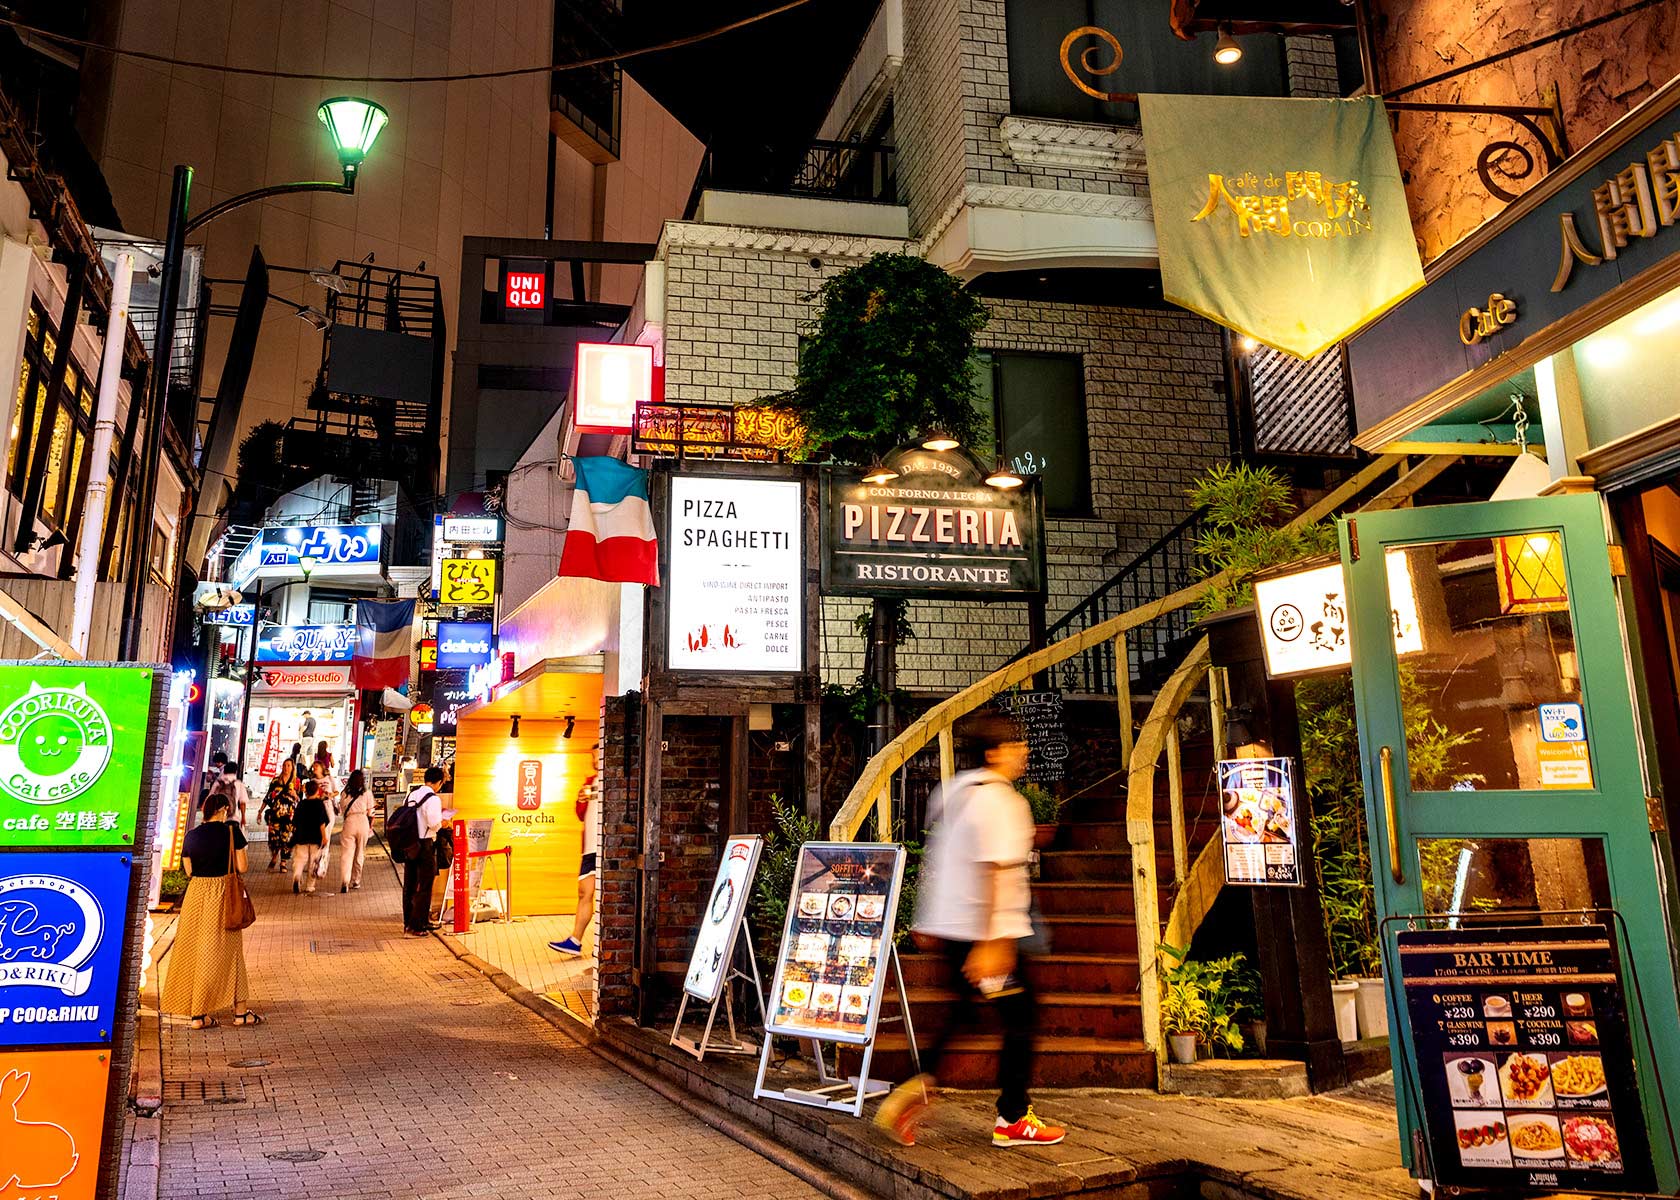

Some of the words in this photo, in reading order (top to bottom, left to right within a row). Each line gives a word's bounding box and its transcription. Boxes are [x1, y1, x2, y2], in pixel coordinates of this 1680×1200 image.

[1293, 218, 1372, 239] COPAIN
[510, 276, 539, 290] UNI
[509, 291, 541, 306] QLO
[902, 461, 929, 477] DAL
[931, 461, 961, 479] 1997
[870, 487, 896, 497] CON
[899, 488, 940, 499] FORNO
[942, 491, 950, 499] A
[683, 499, 738, 519] PIZZA
[843, 504, 1022, 546] PIZZERIA
[302, 528, 369, 563] 占い
[683, 528, 789, 550] SPAGHETTI
[268, 554, 285, 564] 入口
[857, 563, 1009, 583] RISTORANTE
[764, 582, 788, 591] IMPORT
[747, 595, 789, 603] ANTIPASTO
[734, 607, 758, 615] PASTA
[760, 608, 789, 616] FRESCA
[766, 620, 789, 628] PESCE
[764, 633, 789, 641] CARNE
[765, 645, 789, 653] DOLCE
[0, 693, 105, 744] COORIKUYA
[9, 773, 42, 798] Cat
[48, 771, 90, 798] cafe
[3, 814, 50, 831] cafe
[54, 811, 120, 831] 空陸家
[501, 812, 532, 826] Gong
[534, 811, 555, 824] cha
[830, 863, 864, 874] SOFFITTA
[1453, 952, 1495, 968] BAR
[1498, 951, 1554, 967] TIME
[1464, 967, 1495, 976] CLOSE
[1442, 993, 1473, 1002] COFFEE
[1521, 993, 1544, 1002] BEER
[12, 1005, 99, 1023] COO&RIKU
[1444, 1007, 1475, 1019] ¥230
[1524, 1006, 1556, 1018] ¥290
[1526, 1020, 1564, 1029] COCKTAIL
[1449, 1033, 1480, 1046] ¥390
[1529, 1033, 1561, 1046] ¥390
[1022, 1125, 1038, 1138] N
